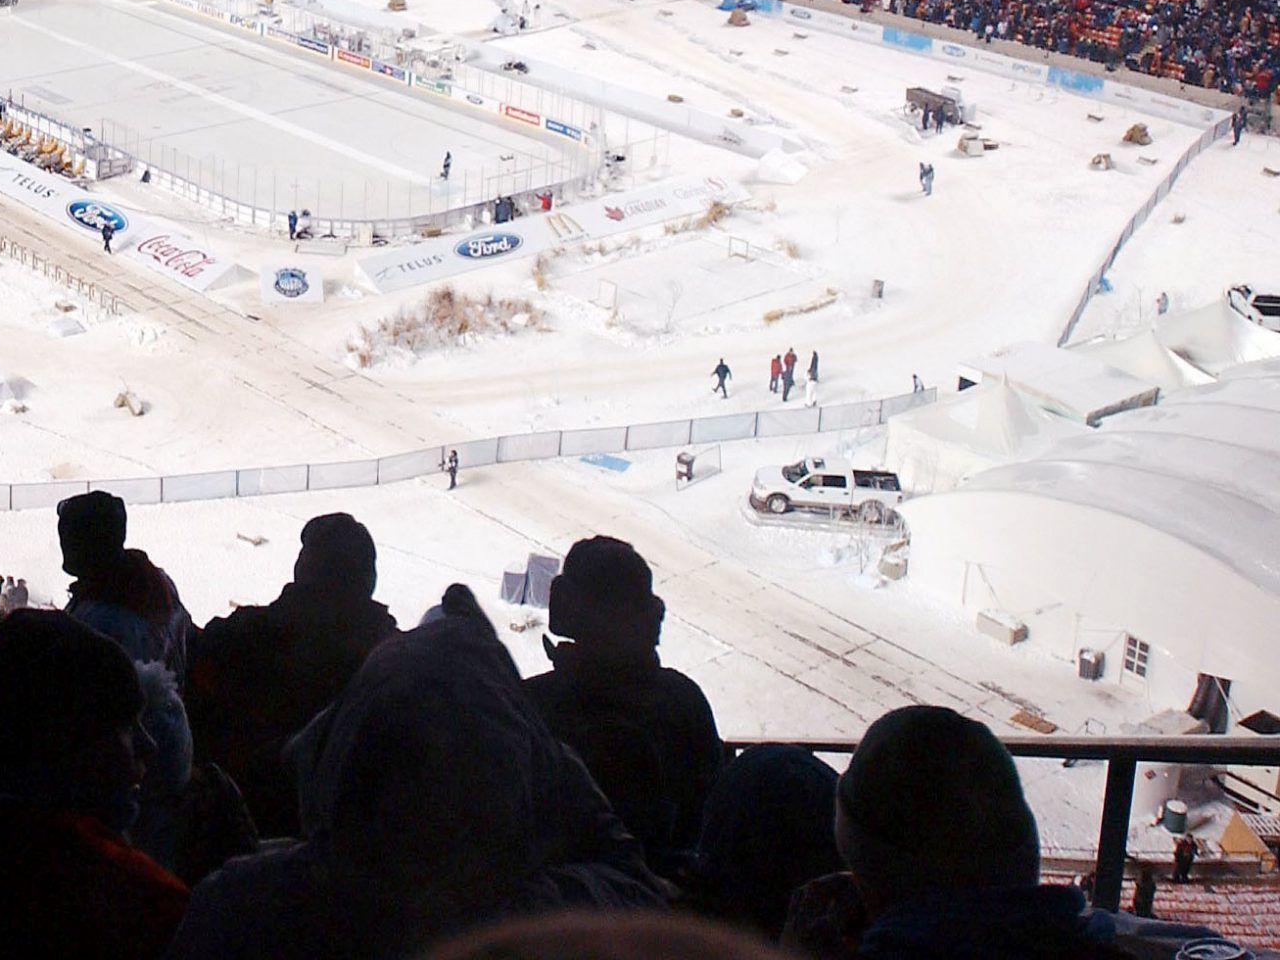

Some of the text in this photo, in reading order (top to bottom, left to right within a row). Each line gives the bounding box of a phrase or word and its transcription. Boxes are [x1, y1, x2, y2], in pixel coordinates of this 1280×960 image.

[230, 14, 258, 29] EPCOR
[11, 172, 55, 199] TELUS
[74, 203, 118, 231] Ford
[624, 198, 667, 216] CANADIAN
[137, 234, 215, 278] Coca-Cola
[469, 235, 512, 257] Ford
[397, 254, 443, 273] TELUS
